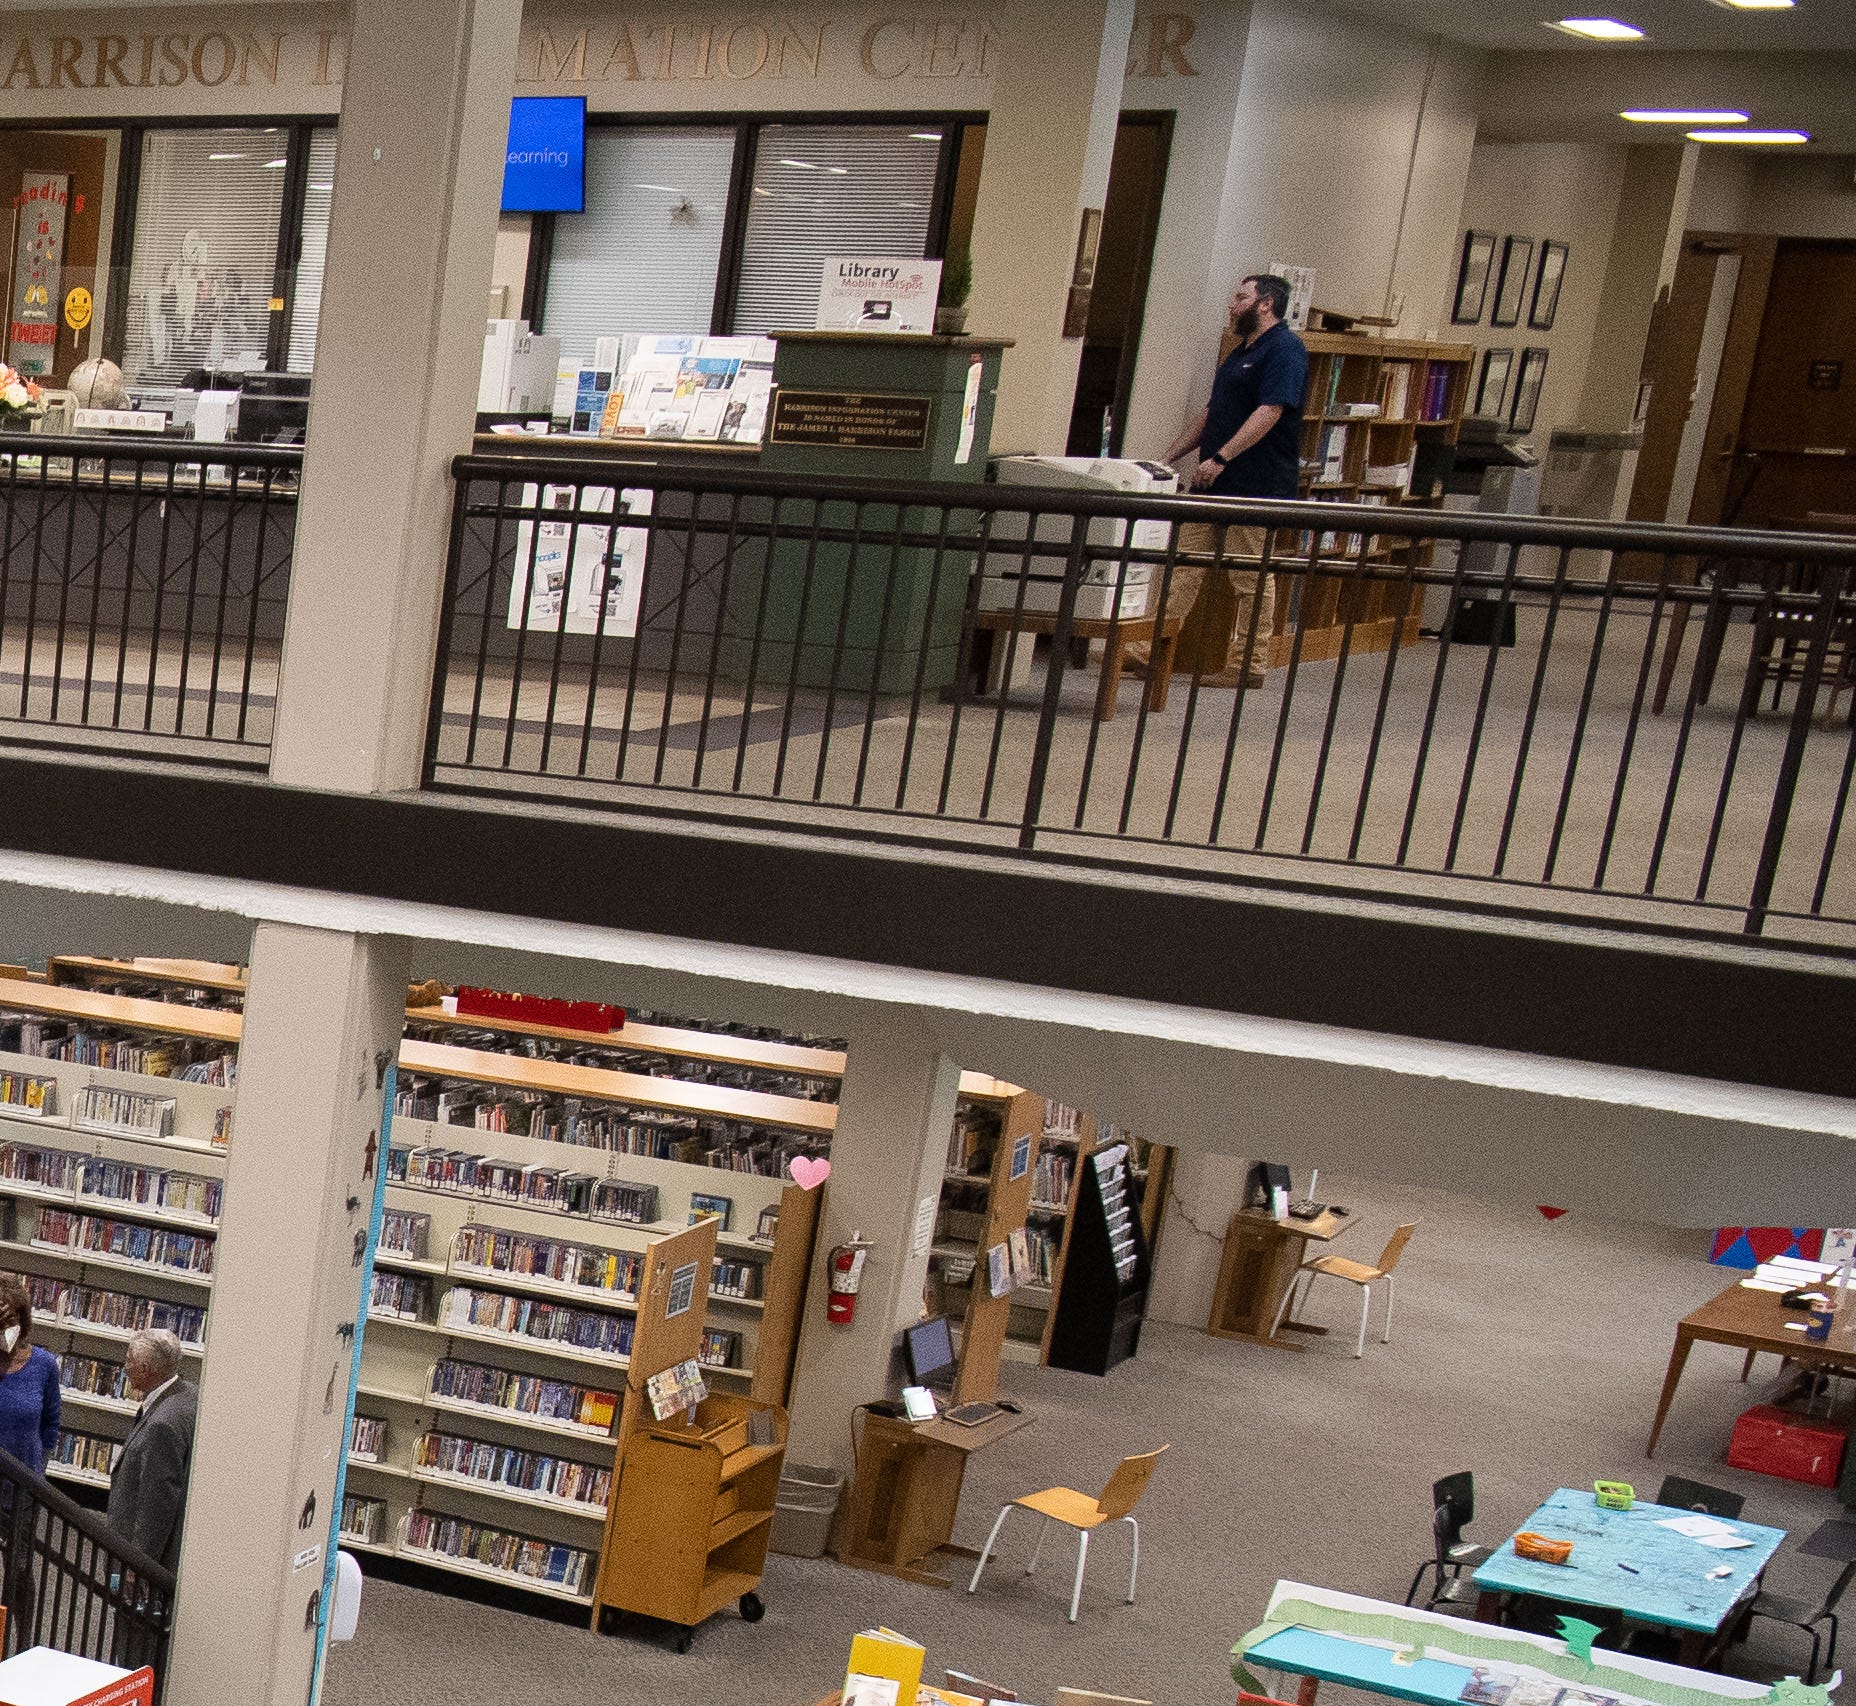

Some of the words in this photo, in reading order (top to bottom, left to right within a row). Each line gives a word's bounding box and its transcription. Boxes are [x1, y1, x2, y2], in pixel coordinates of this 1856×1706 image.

[506, 147, 568, 168] earning
[839, 262, 900, 281] Library
[124, 1676, 149, 1699] STATION
